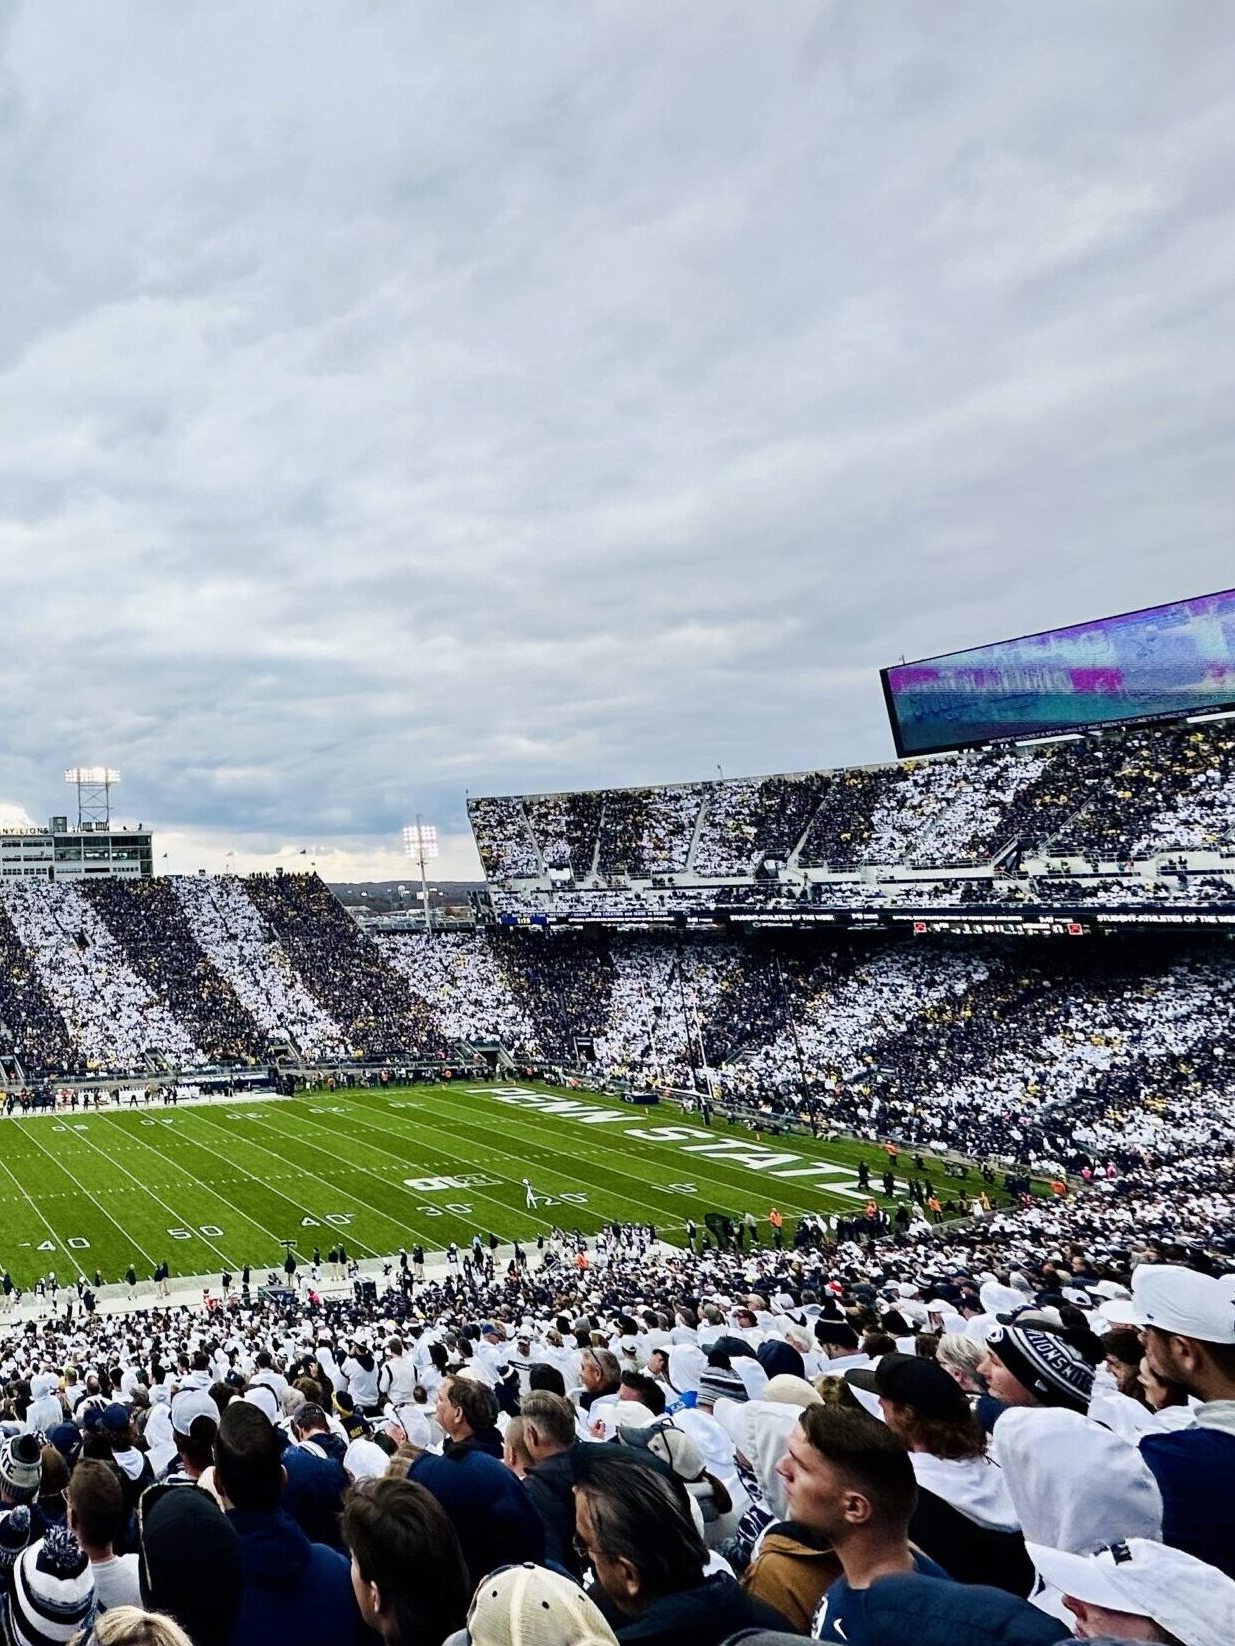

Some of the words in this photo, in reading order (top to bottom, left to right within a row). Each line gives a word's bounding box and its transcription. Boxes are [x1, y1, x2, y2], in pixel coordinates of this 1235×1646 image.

[466, 1086, 647, 1123] PENN
[623, 1126, 913, 1200] STATE
[416, 1203, 472, 1216] 30
[301, 1213, 351, 1228] 40
[166, 1225, 224, 1240] 50
[36, 1236, 91, 1252] 40
